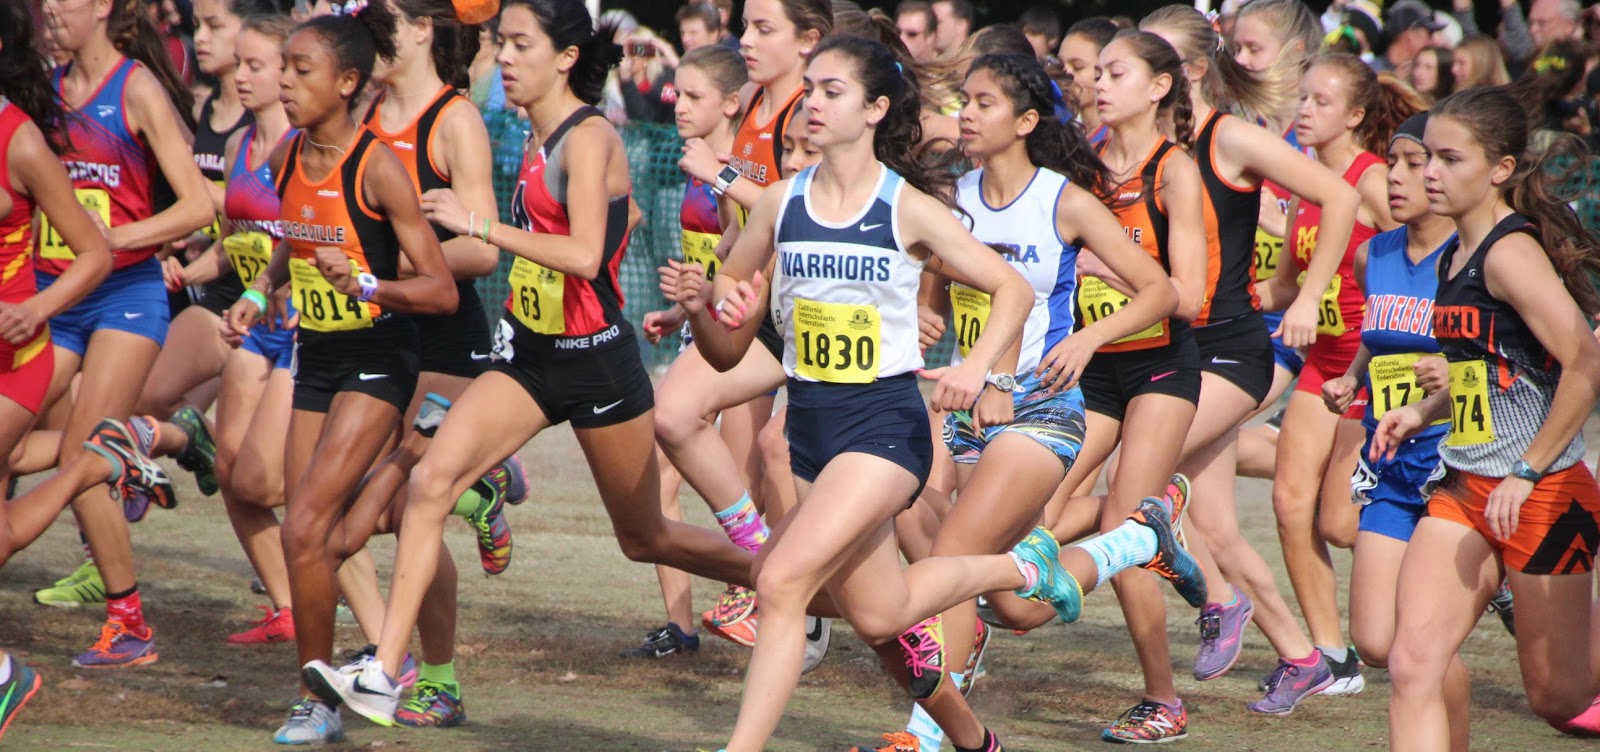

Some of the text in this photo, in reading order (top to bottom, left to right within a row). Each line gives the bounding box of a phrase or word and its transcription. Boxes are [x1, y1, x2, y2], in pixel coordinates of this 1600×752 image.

[781, 250, 891, 282] WARRIORS
[299, 288, 363, 321] 1814
[797, 303, 823, 314] California
[797, 310, 837, 323] Interscholastic
[798, 317, 826, 328] Federation
[555, 324, 620, 350] NIKE PRO
[801, 330, 875, 371] 1830
[1373, 359, 1400, 369] California
[1376, 372, 1406, 382] Federation
